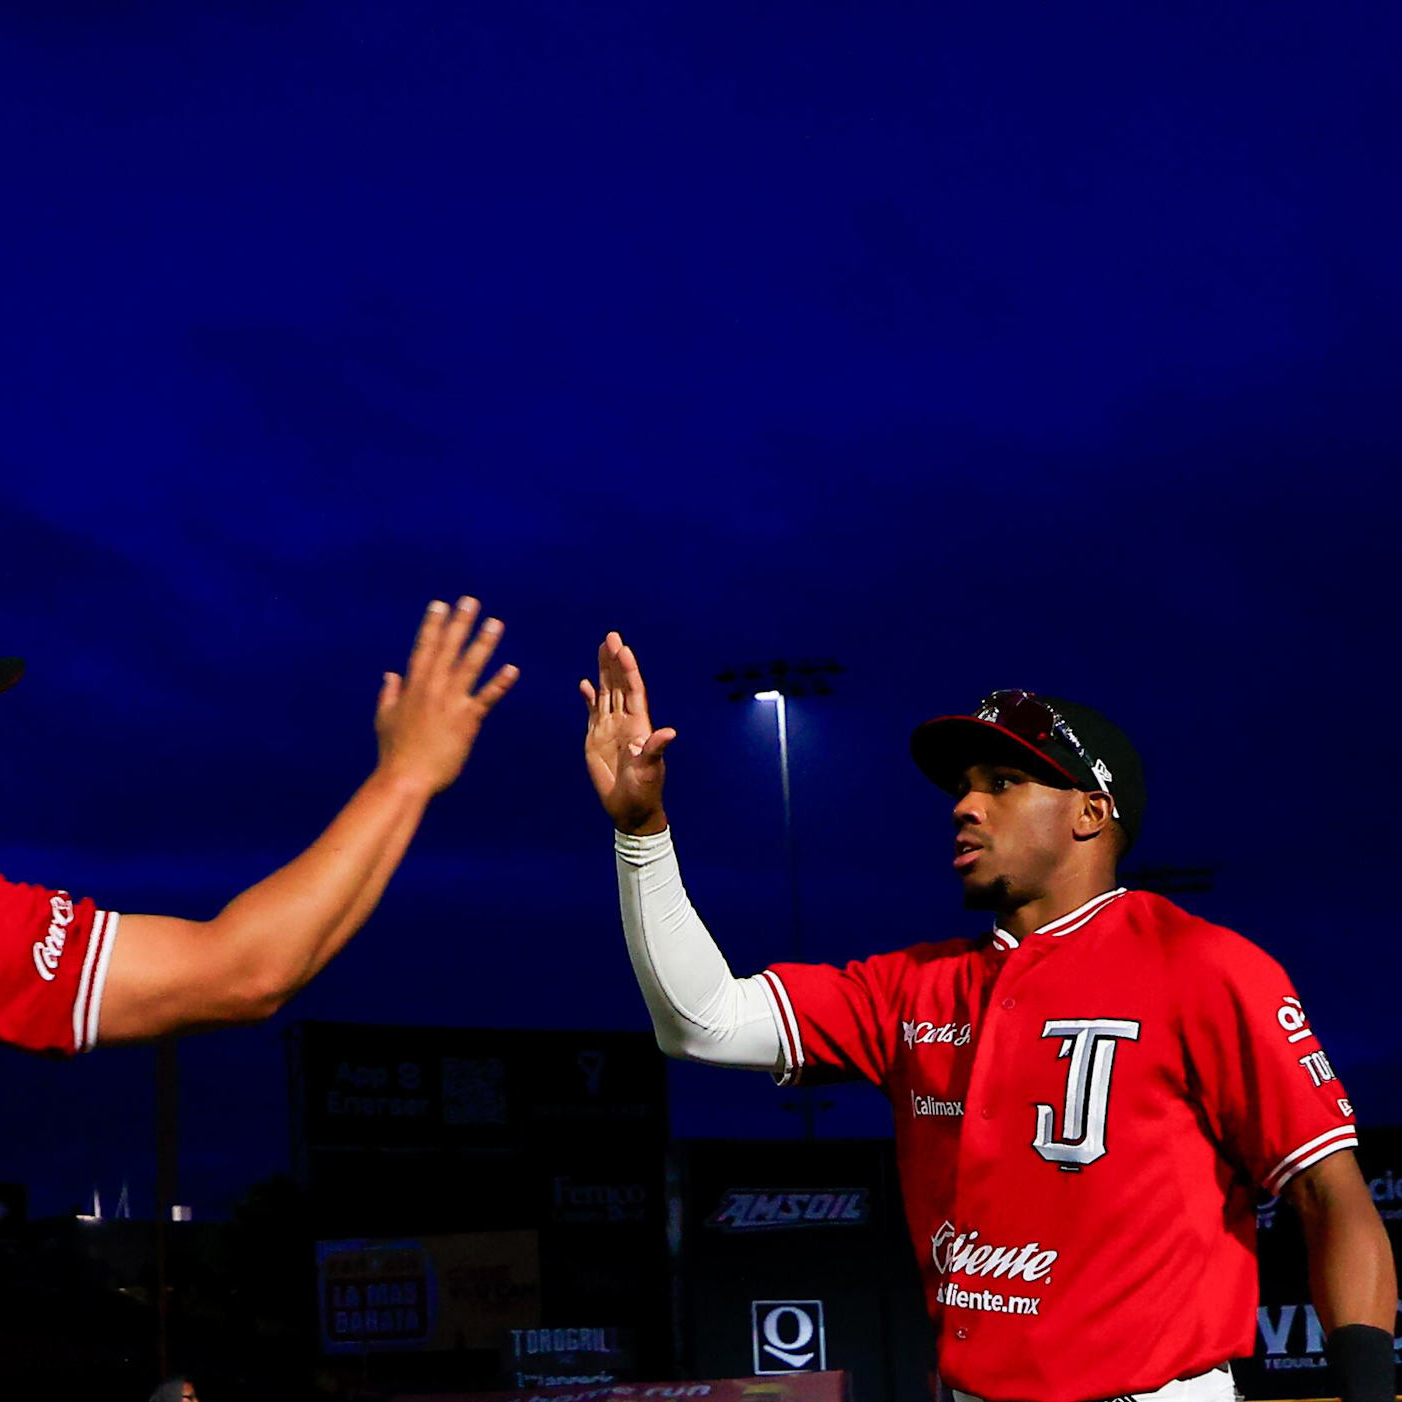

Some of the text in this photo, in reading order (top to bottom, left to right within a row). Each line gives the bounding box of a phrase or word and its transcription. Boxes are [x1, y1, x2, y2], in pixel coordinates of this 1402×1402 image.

[914, 1022, 957, 1043] Carl's
[914, 1095, 964, 1116] Calimax
[714, 1191, 865, 1229] AMSOIL
[762, 1305, 815, 1369] Q
[1263, 1357, 1328, 1371] TEQUILA
